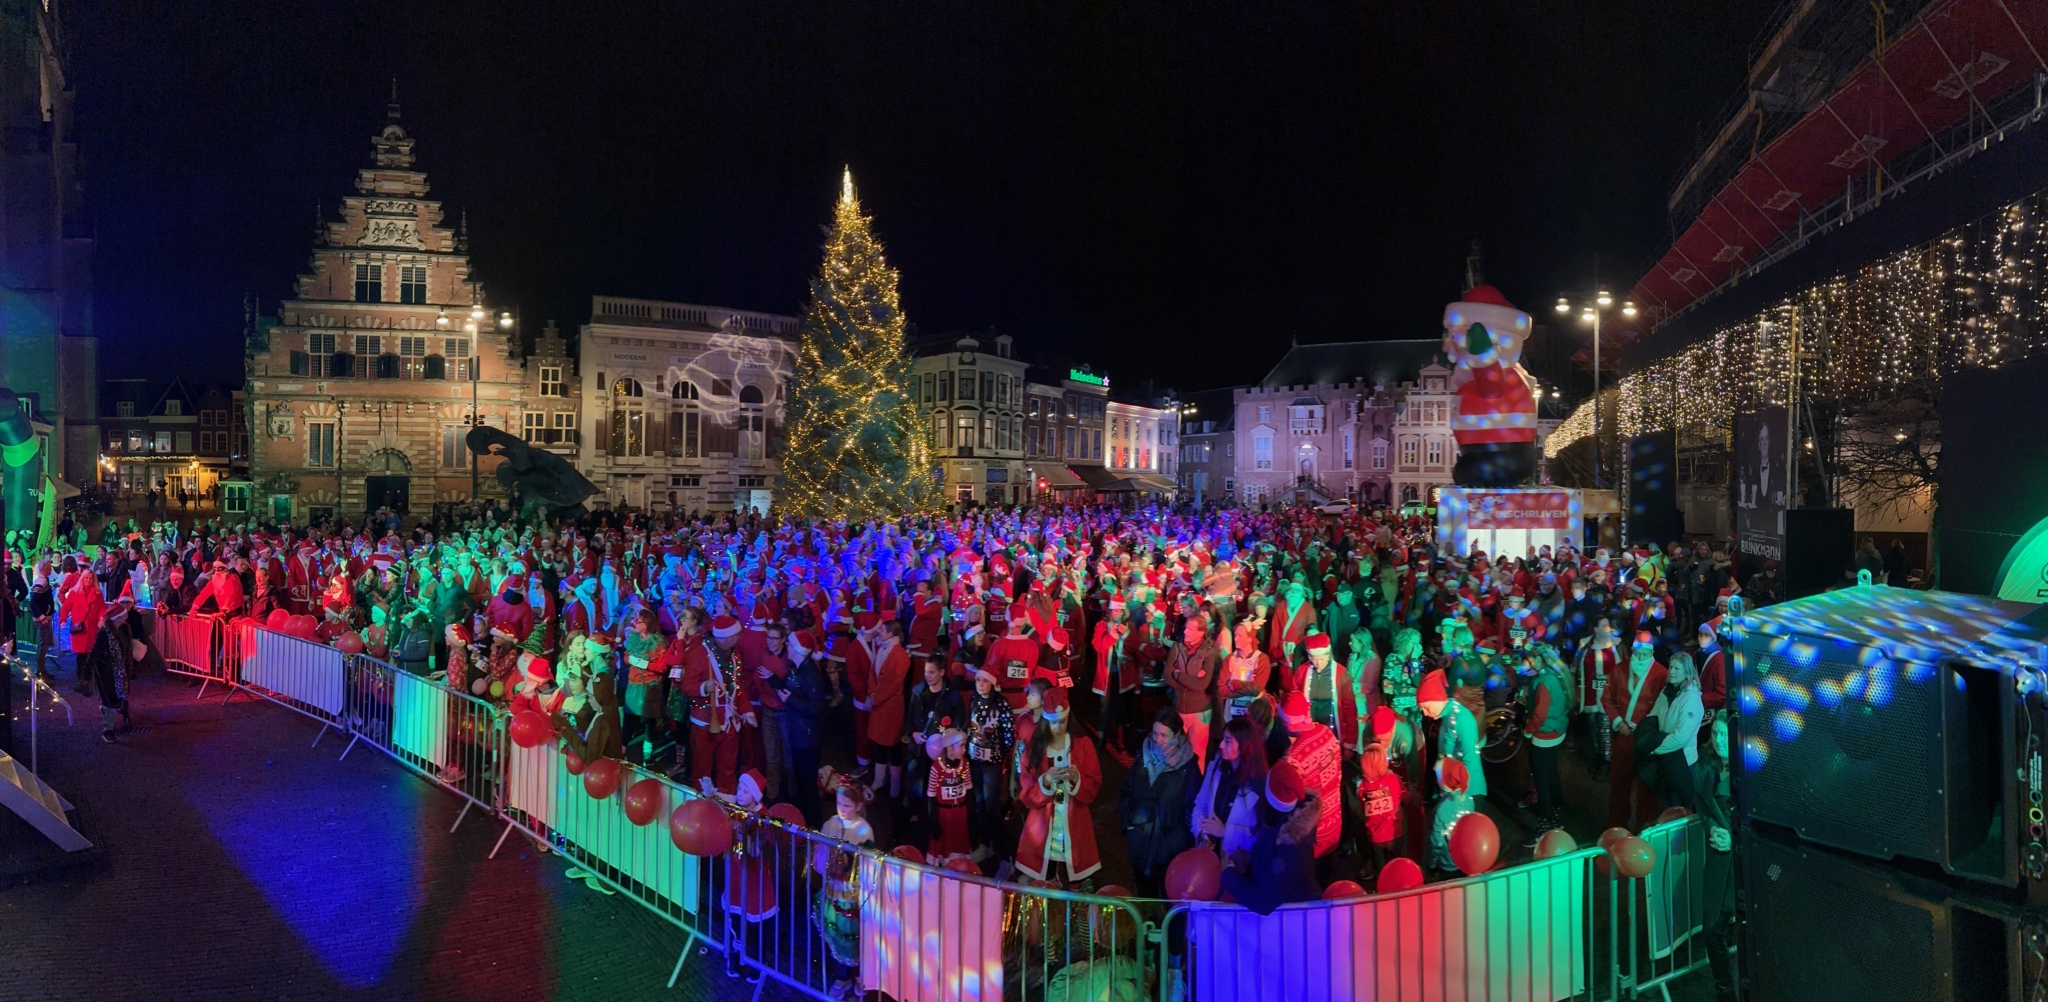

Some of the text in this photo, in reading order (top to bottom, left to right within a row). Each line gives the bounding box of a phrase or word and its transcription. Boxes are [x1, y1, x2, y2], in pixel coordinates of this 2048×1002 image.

[614, 353, 646, 361] MODERNE
[1070, 369, 1103, 385] Heineken
[1495, 509, 1568, 519] INSCHRIJVEN
[1010, 668, 1026, 678] 214
[945, 785, 964, 798] 152
[1366, 798, 1390, 814] 242
